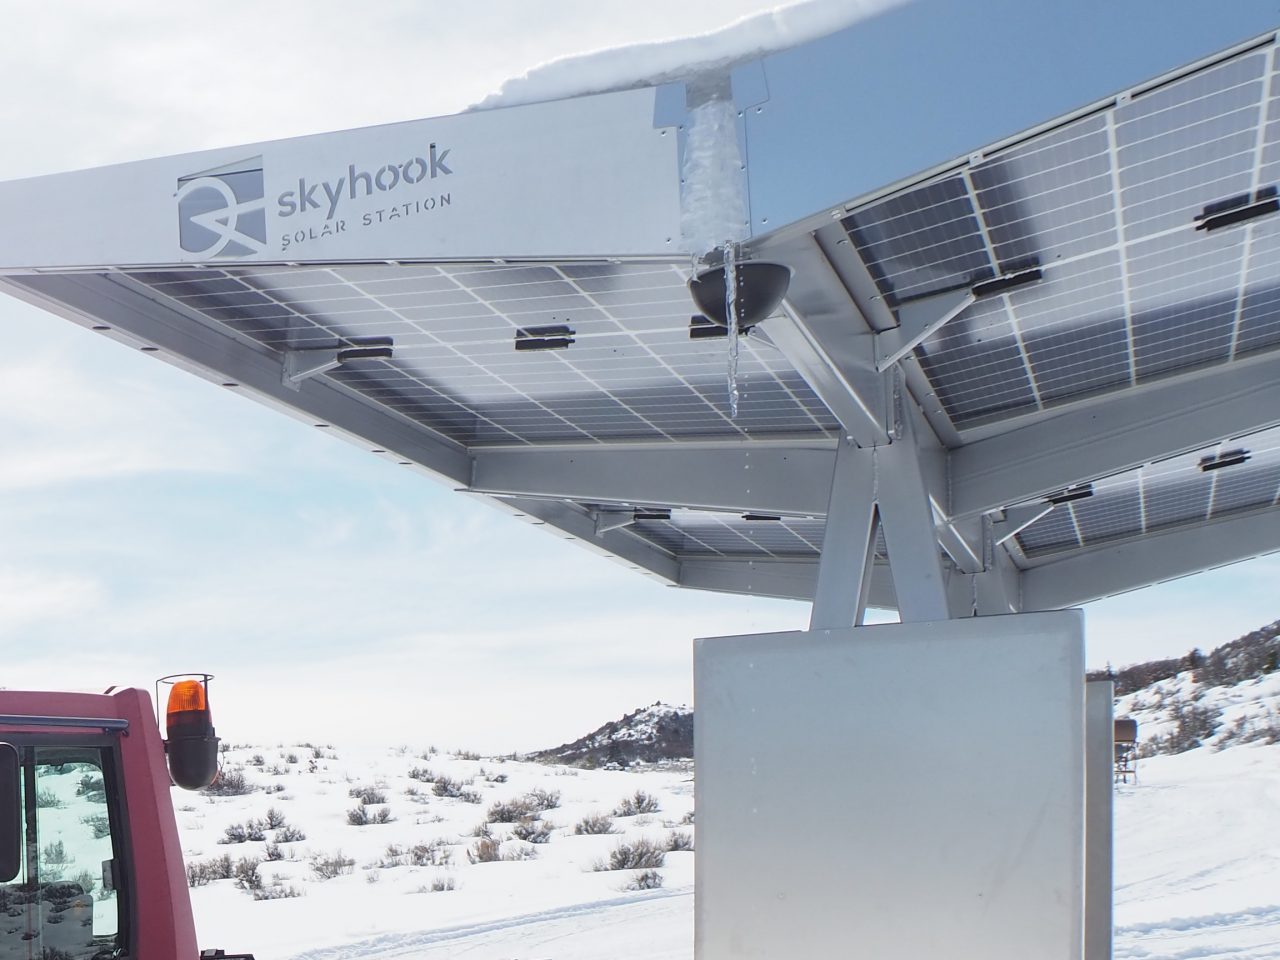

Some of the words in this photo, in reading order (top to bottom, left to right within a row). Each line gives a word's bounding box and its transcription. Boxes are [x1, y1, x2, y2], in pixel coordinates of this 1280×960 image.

[277, 142, 453, 220] skyhook
[281, 219, 346, 248] SOLAR
[362, 192, 452, 227] STATION
